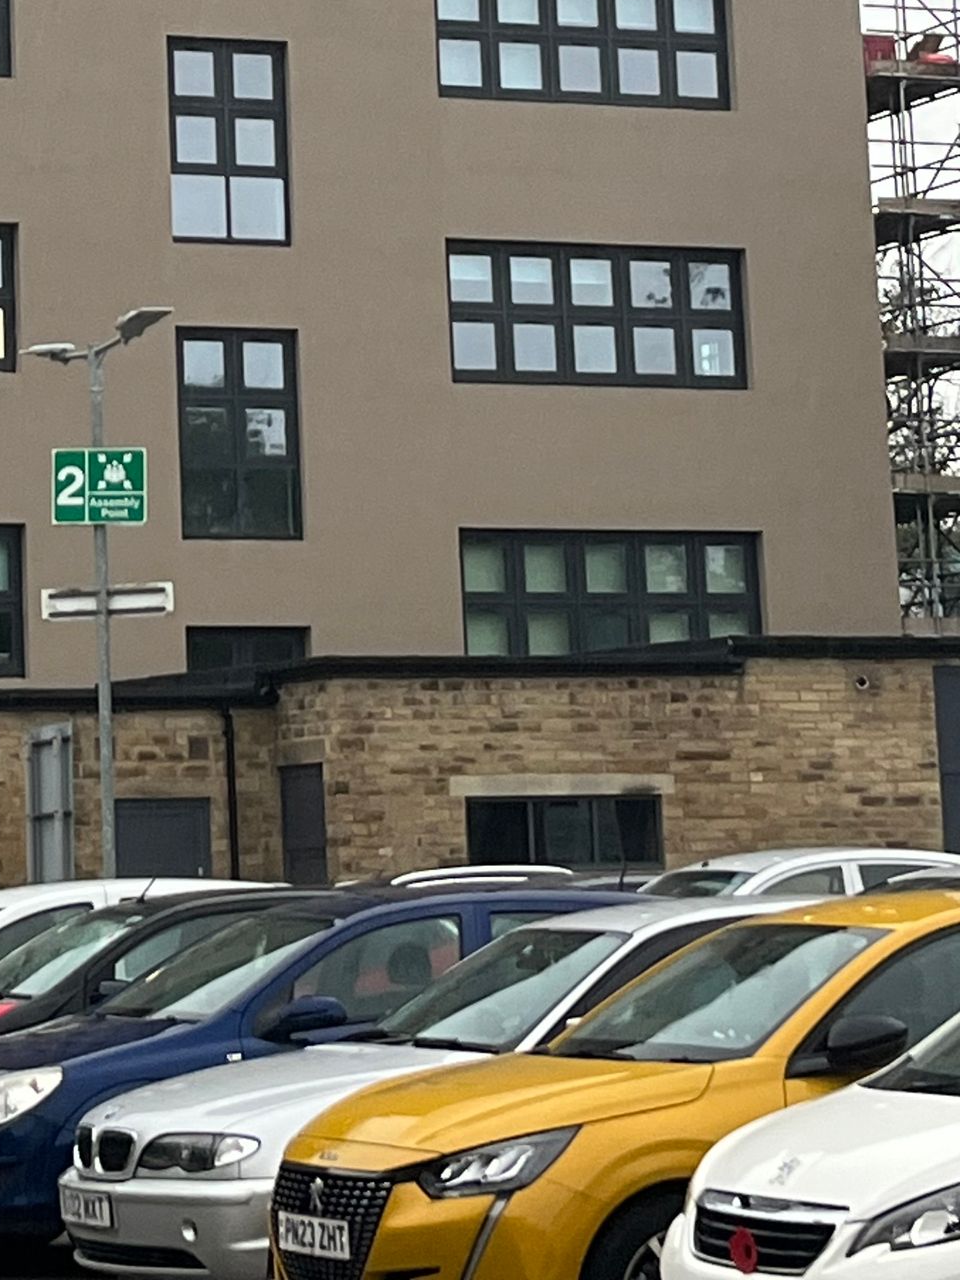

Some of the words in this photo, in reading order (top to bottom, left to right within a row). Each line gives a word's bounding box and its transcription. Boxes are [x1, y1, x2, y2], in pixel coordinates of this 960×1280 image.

[57, 465, 84, 506] 2
[90, 497, 140, 510] Assembly
[101, 508, 128, 519] Point
[285, 1216, 315, 1248] PN23
[318, 1222, 345, 1252] ZHT
